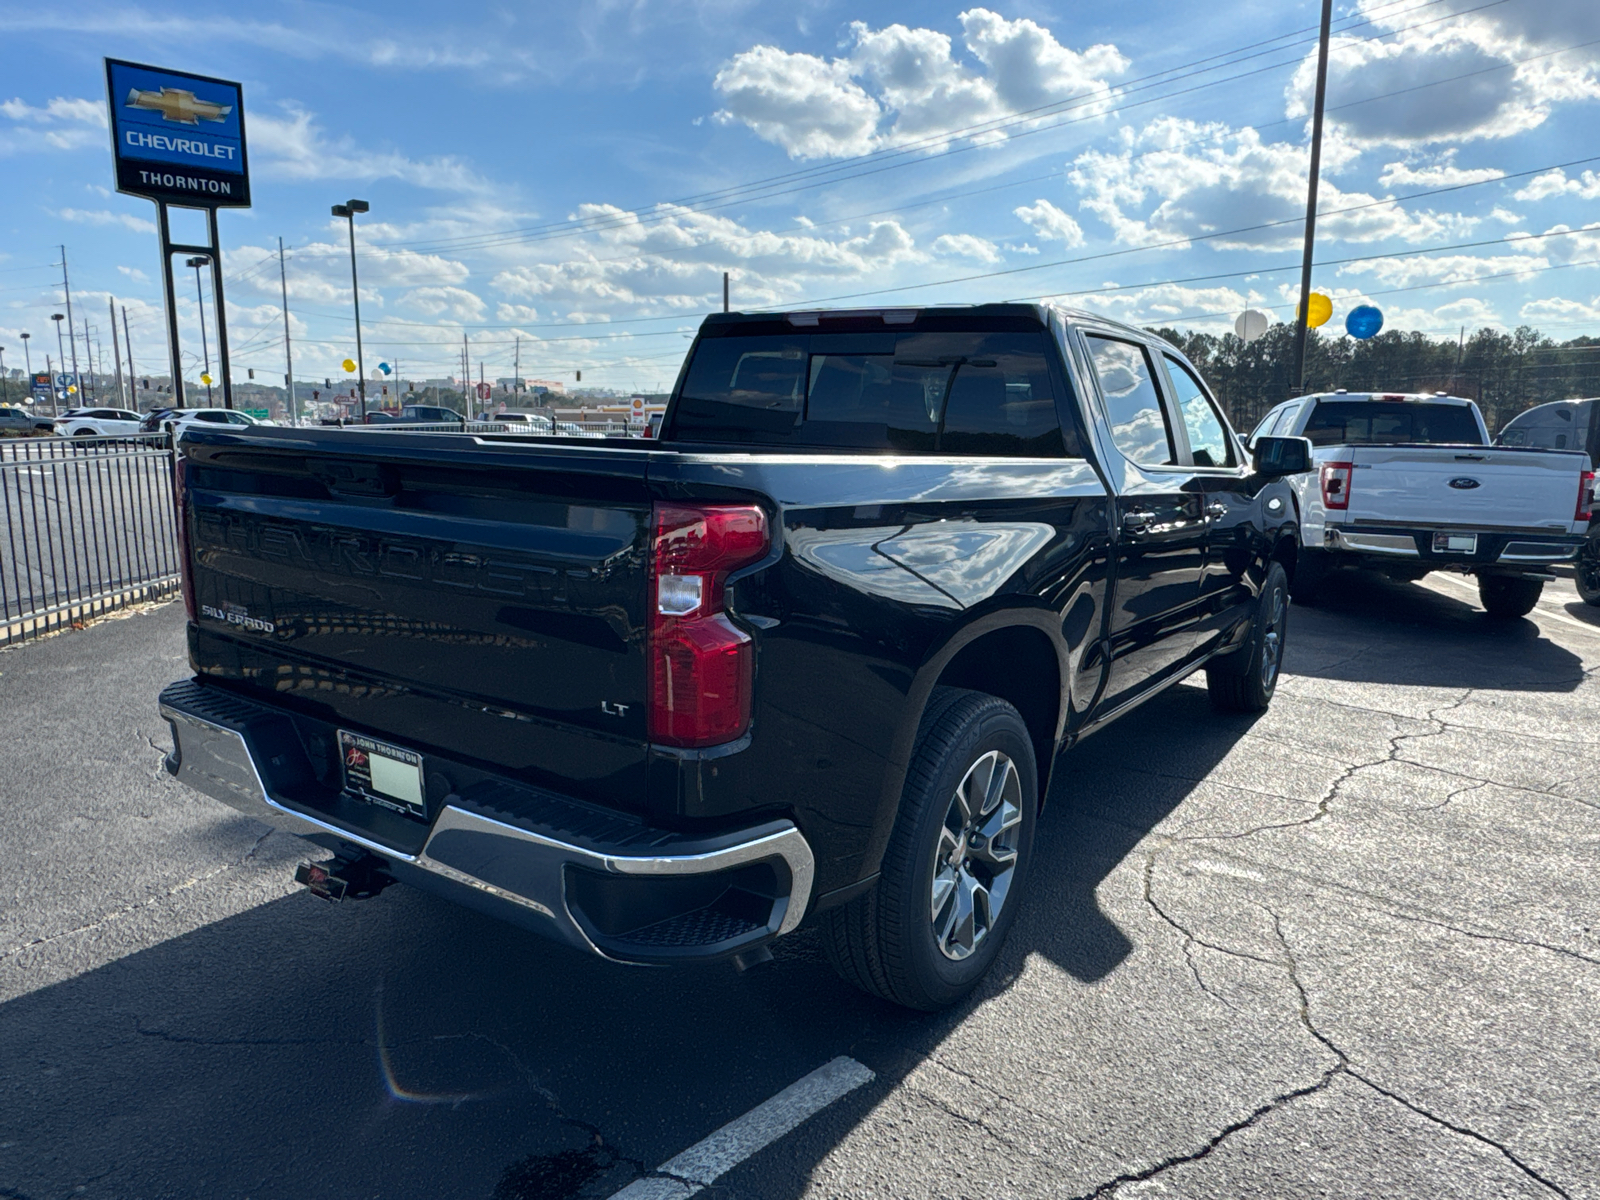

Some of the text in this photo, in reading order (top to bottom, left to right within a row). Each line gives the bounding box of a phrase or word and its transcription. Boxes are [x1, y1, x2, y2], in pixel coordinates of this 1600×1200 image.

[126, 131, 236, 160] CHEVROLET
[139, 170, 231, 194] THORNTON
[198, 511, 597, 601] CHEVROLET
[202, 604, 274, 633] SILVERADO
[601, 700, 629, 717] LT
[356, 737, 375, 750] JOHN
[376, 744, 417, 764] THORNTON
